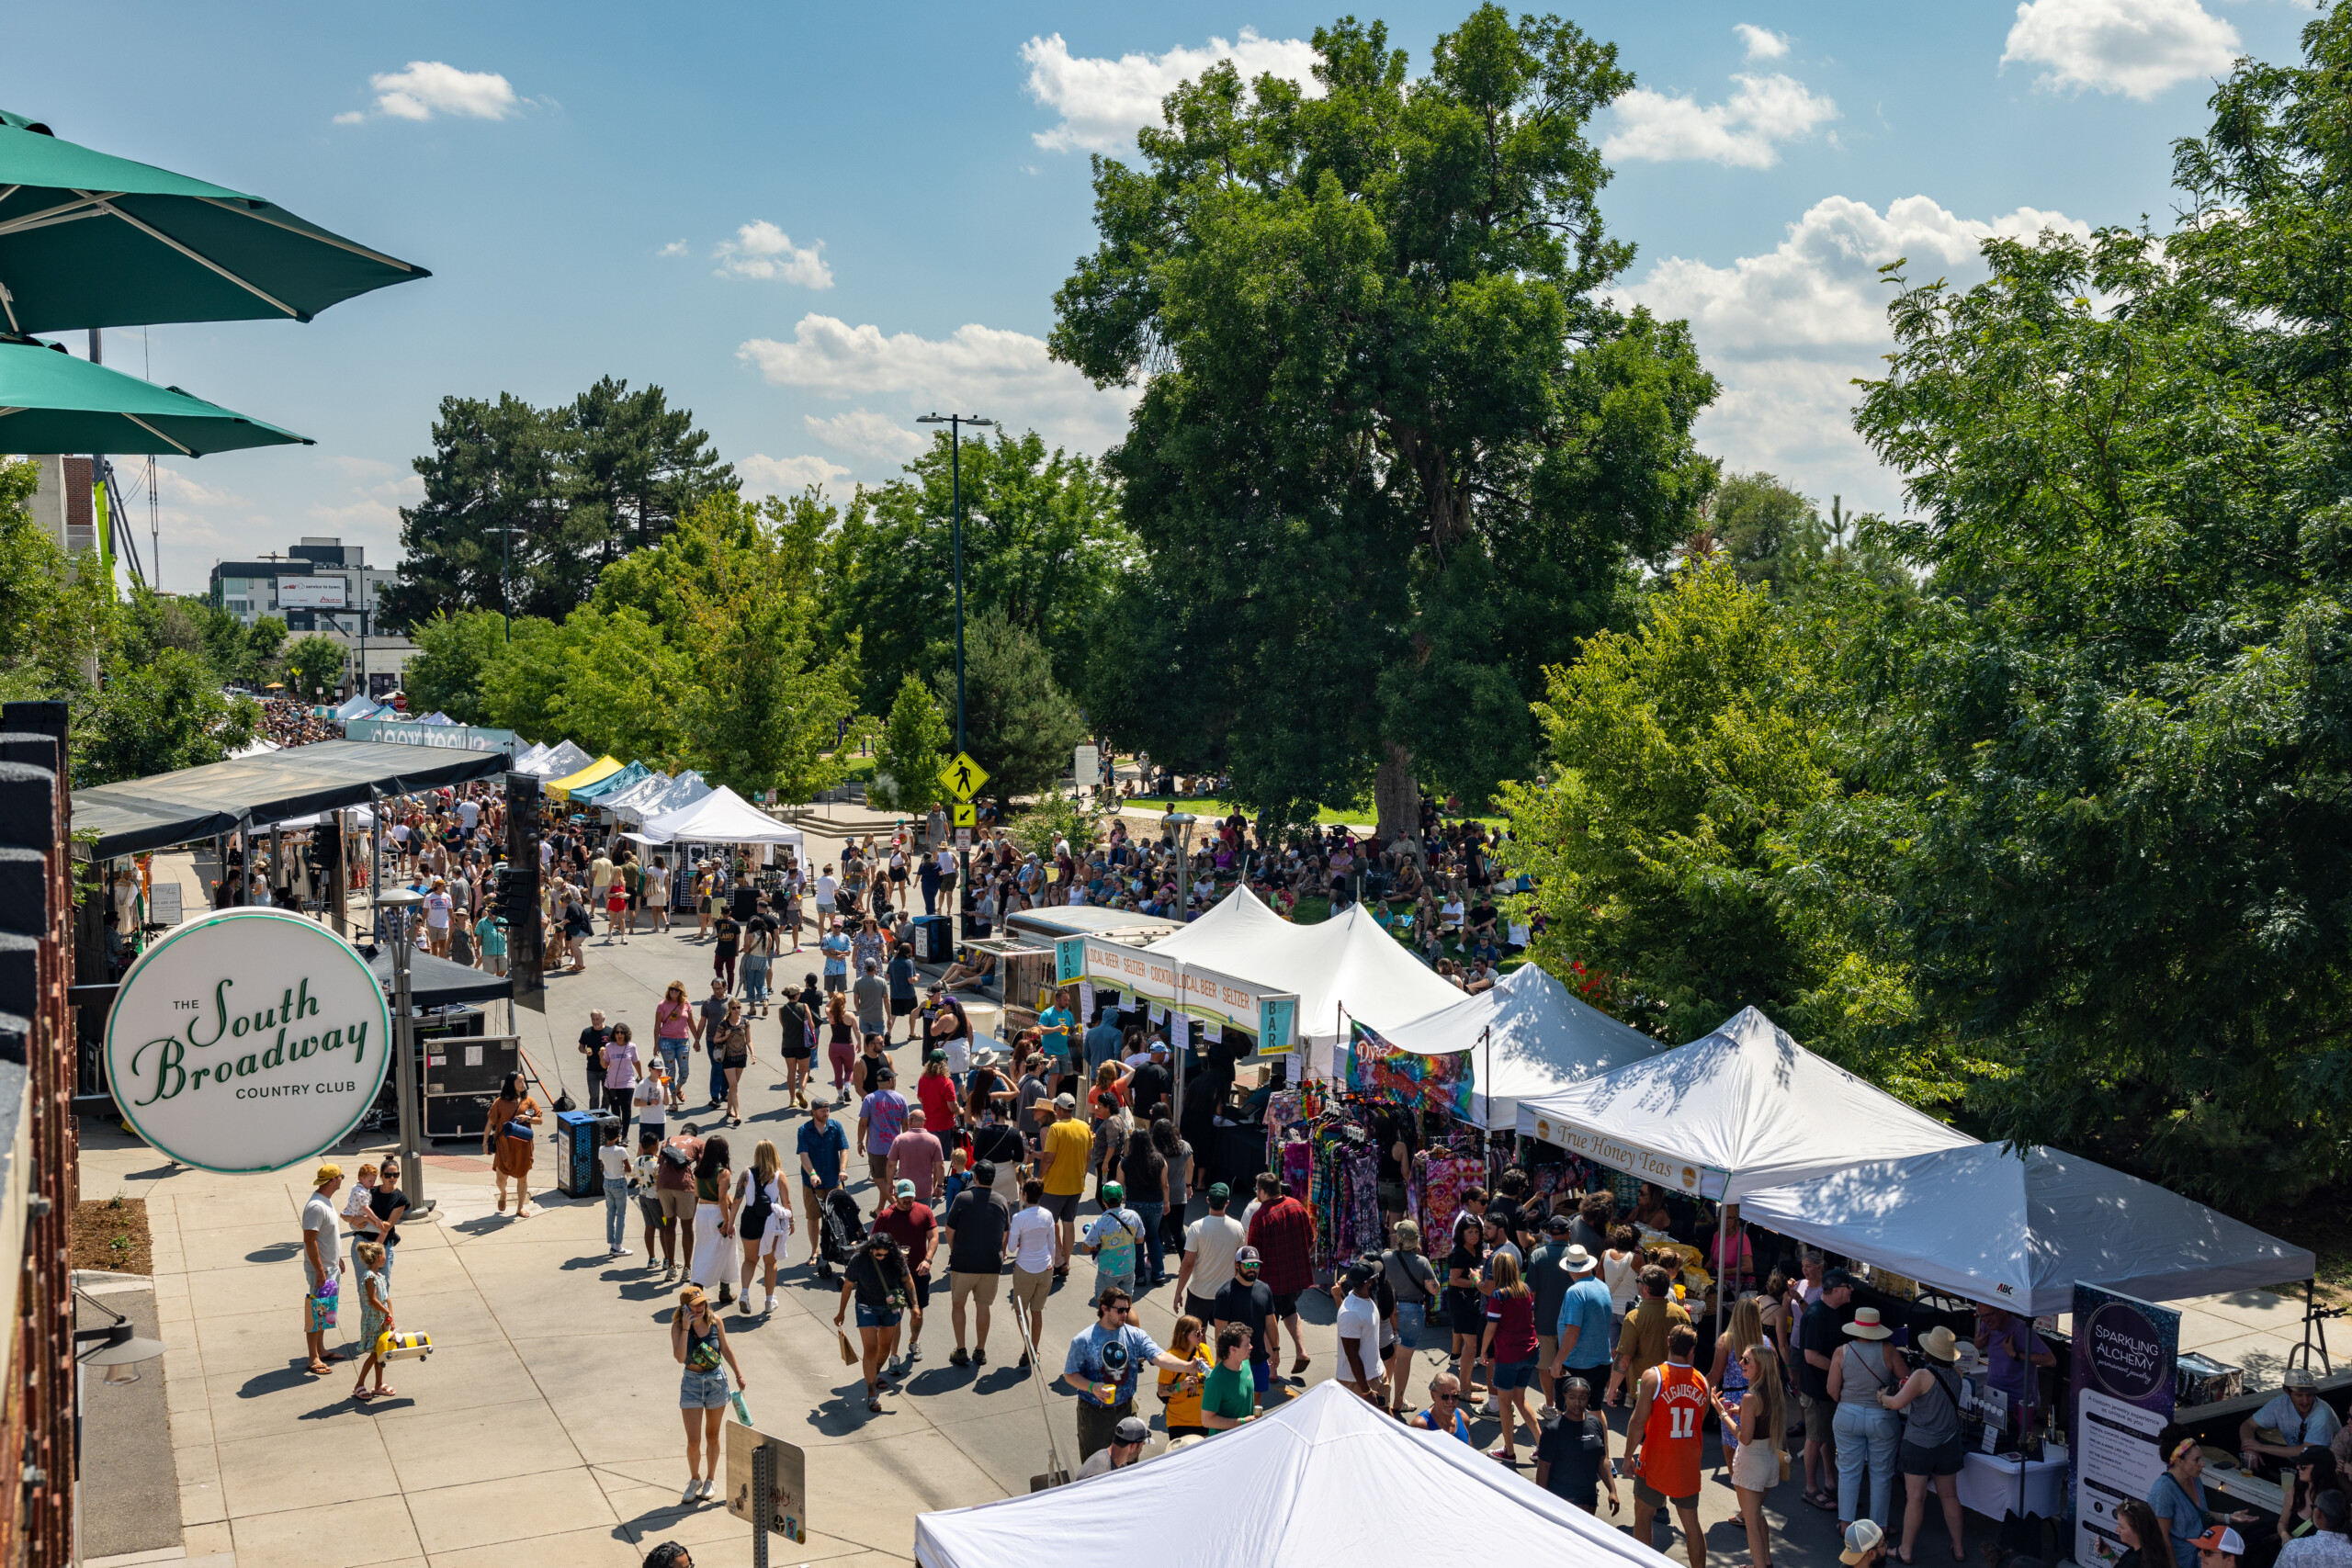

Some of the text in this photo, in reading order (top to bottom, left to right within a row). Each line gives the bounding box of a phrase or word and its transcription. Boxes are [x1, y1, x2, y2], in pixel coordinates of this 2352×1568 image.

[1062, 942, 1071, 979] BAR
[1087, 948, 1104, 965] LOCAL
[1105, 953, 1119, 969] BEER
[1124, 958, 1147, 977] SELTZER
[173, 999, 199, 1010] THE
[1177, 973, 1250, 1010] LOCAL BEER SELTZER
[187, 977, 320, 1047] South
[1268, 1001, 1277, 1047] BAR
[131, 1021, 368, 1106] Broadway
[235, 1081, 356, 1099] COUNTRY CLUB
[1557, 1125, 1672, 1178] True Honey Teas
[1996, 1282, 2013, 1295] ABC
[2096, 1325, 2158, 1356] SPARKLING
[2097, 1342, 2154, 1371] ALCHEMY
[2097, 1359, 2152, 1385] permanent jewelry
[1661, 1383, 1707, 1407] ILGAUSKAS
[1670, 1407, 1695, 1438] 11
[2092, 1398, 2110, 1407] custom
[2111, 1404, 2131, 1416] jewelry
[2131, 1411, 2159, 1426] experience
[2109, 1409, 2126, 1420] unique
[2133, 1418, 2143, 1427] you
